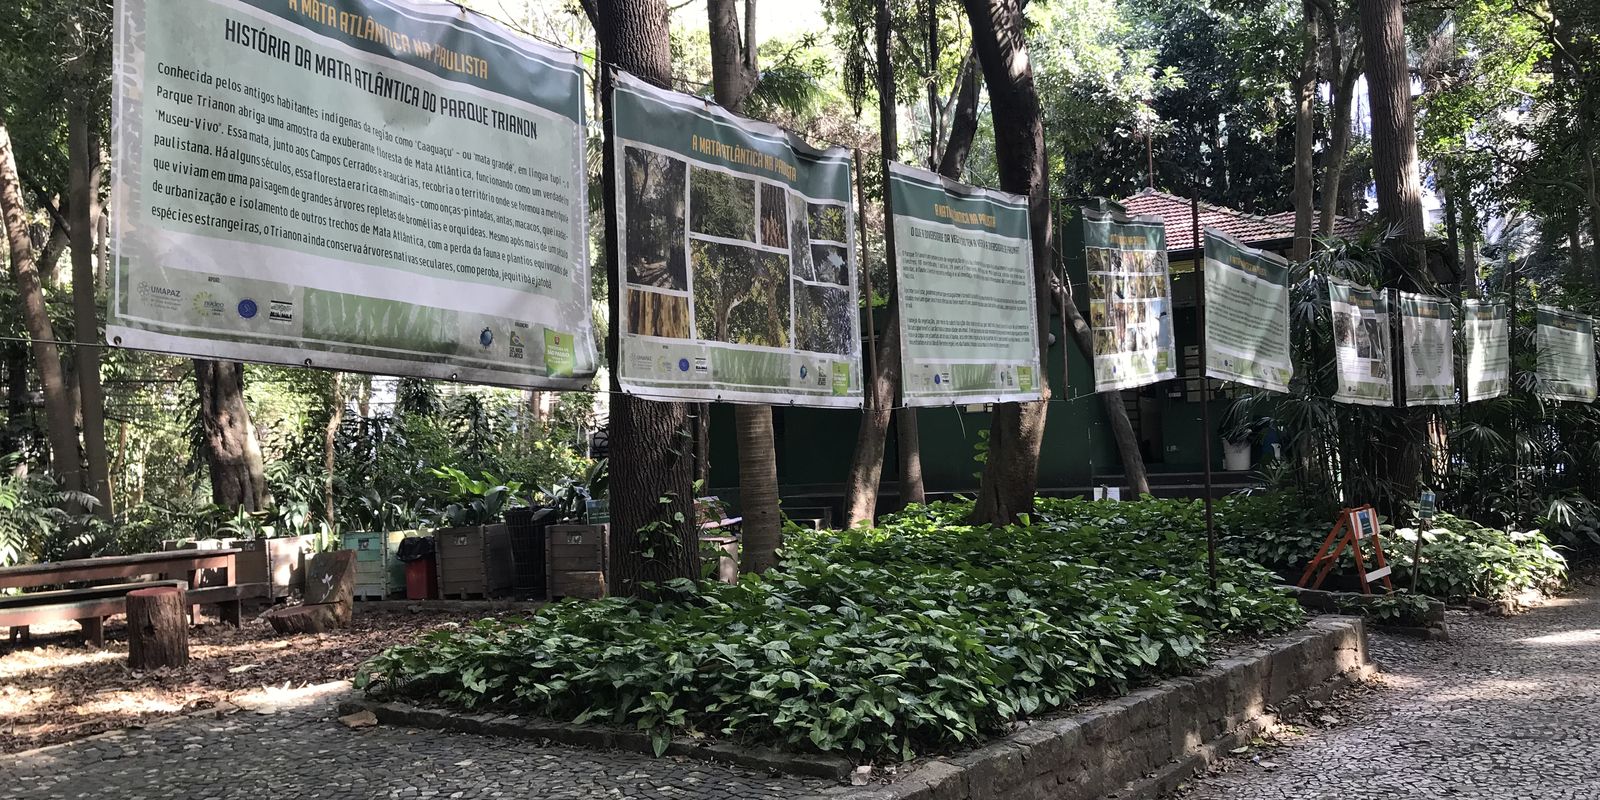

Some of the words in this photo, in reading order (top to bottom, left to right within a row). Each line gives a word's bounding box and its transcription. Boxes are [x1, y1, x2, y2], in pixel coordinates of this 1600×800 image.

[225, 18, 290, 62] HISTÓRIA
[295, 45, 311, 71] DA
[315, 54, 352, 83] MATA
[355, 68, 420, 107] ATLÂNTICA
[422, 90, 436, 113] DO
[440, 96, 489, 126] PARQUE
[491, 109, 538, 140] TRIANON
[340, 11, 411, 54] ATLÂNTICA
[413, 38, 432, 61] NA
[434, 43, 488, 80] PAULISTA
[156, 85, 193, 105] Parque
[196, 94, 236, 113] Trianon
[238, 105, 266, 124] abriga
[267, 116, 284, 129] uma
[286, 122, 318, 139] amostra
[320, 130, 330, 143] da
[332, 135, 375, 154] exuberante
[376, 145, 402, 164] floresta
[403, 156, 413, 168] de
[415, 159, 433, 172] Mata
[435, 164, 474, 181] Atlântica,
[476, 170, 513, 190] funcionando
[514, 182, 531, 195] como
[532, 188, 541, 197] um
[157, 62, 213, 85] Conhecida
[215, 77, 242, 92] pelos
[244, 85, 275, 104] antigos
[276, 94, 319, 119] habitantes
[321, 109, 362, 130] indígenas
[363, 122, 371, 133] da
[394, 135, 413, 148] como
[462, 151, 472, 160] ou
[518, 166, 527, 176] em
[550, 173, 562, 187] tupi
[227, 124, 248, 141] Essa
[249, 131, 271, 148] mata,
[273, 137, 294, 154] junto
[295, 146, 309, 158] aos
[310, 148, 341, 167] Campos
[342, 157, 377, 175] Cerrados
[378, 168, 382, 177] e
[382, 168, 421, 189] araucárias,
[422, 180, 454, 196] recobria
[455, 186, 460, 196] o
[461, 186, 495, 204] território
[495, 196, 510, 208] onde
[511, 200, 518, 210] se
[518, 200, 540, 216] formou
[540, 207, 545, 216] a
[692, 134, 698, 151] A
[700, 136, 721, 157] MATA
[721, 144, 763, 168] ATLÂNTICA
[774, 158, 797, 182] PASTA
[152, 180, 163, 194] de
[165, 185, 228, 205] urbanização
[229, 196, 236, 207] e
[239, 195, 288, 217] isolamento
[290, 207, 300, 220] de
[301, 212, 327, 226] outros
[328, 216, 359, 233] trechos
[360, 222, 370, 234] de
[372, 225, 391, 239] Mata
[392, 229, 426, 248] Atlântica,
[427, 239, 443, 251] com
[443, 242, 448, 252] a
[449, 242, 471, 255] perda
[472, 245, 481, 256] da
[483, 246, 501, 260] fauna
[501, 252, 506, 261] e
[506, 253, 533, 267] plantios
[153, 158, 170, 171] que
[172, 161, 209, 178] viviam
[211, 169, 226, 181] em
[228, 172, 248, 185] uma
[249, 177, 289, 196] paisagem
[290, 186, 300, 198] de
[301, 189, 333, 207] grandes
[334, 196, 365, 213] árvores
[366, 204, 397, 220] repletas
[397, 211, 405, 223] de
[405, 214, 442, 232] bromélias
[443, 223, 448, 232] e
[489, 230, 510, 244] Mesmo
[524, 238, 539, 251] mais
[540, 242, 547, 252] de
[154, 134, 212, 156] paulistana.
[215, 145, 228, 159] Há
[230, 149, 260, 166] alguns
[261, 157, 294, 177] séculos,
[295, 167, 313, 180] essa
[313, 170, 346, 188] floresta
[347, 179, 361, 191] era
[361, 181, 378, 195] rica
[378, 186, 388, 197] em
[388, 189, 415, 206] animais
[420, 200, 439, 211] como
[440, 202, 496, 223] onças-pintadas,
[496, 215, 514, 228] antas,
[514, 218, 542, 234] macacos,
[151, 205, 193, 223] espécies
[195, 214, 262, 236] estrangeiras,
[263, 225, 269, 235] o
[270, 225, 302, 242] Trianon
[303, 233, 325, 247] ainda
[326, 238, 362, 254] conserva
[363, 243, 393, 259] árvores
[393, 250, 419, 265] nativas
[419, 257, 456, 273] seculares,
[456, 262, 476, 274] como
[476, 266, 501, 279] peroba,
[151, 286, 181, 298] UMAPAZ
